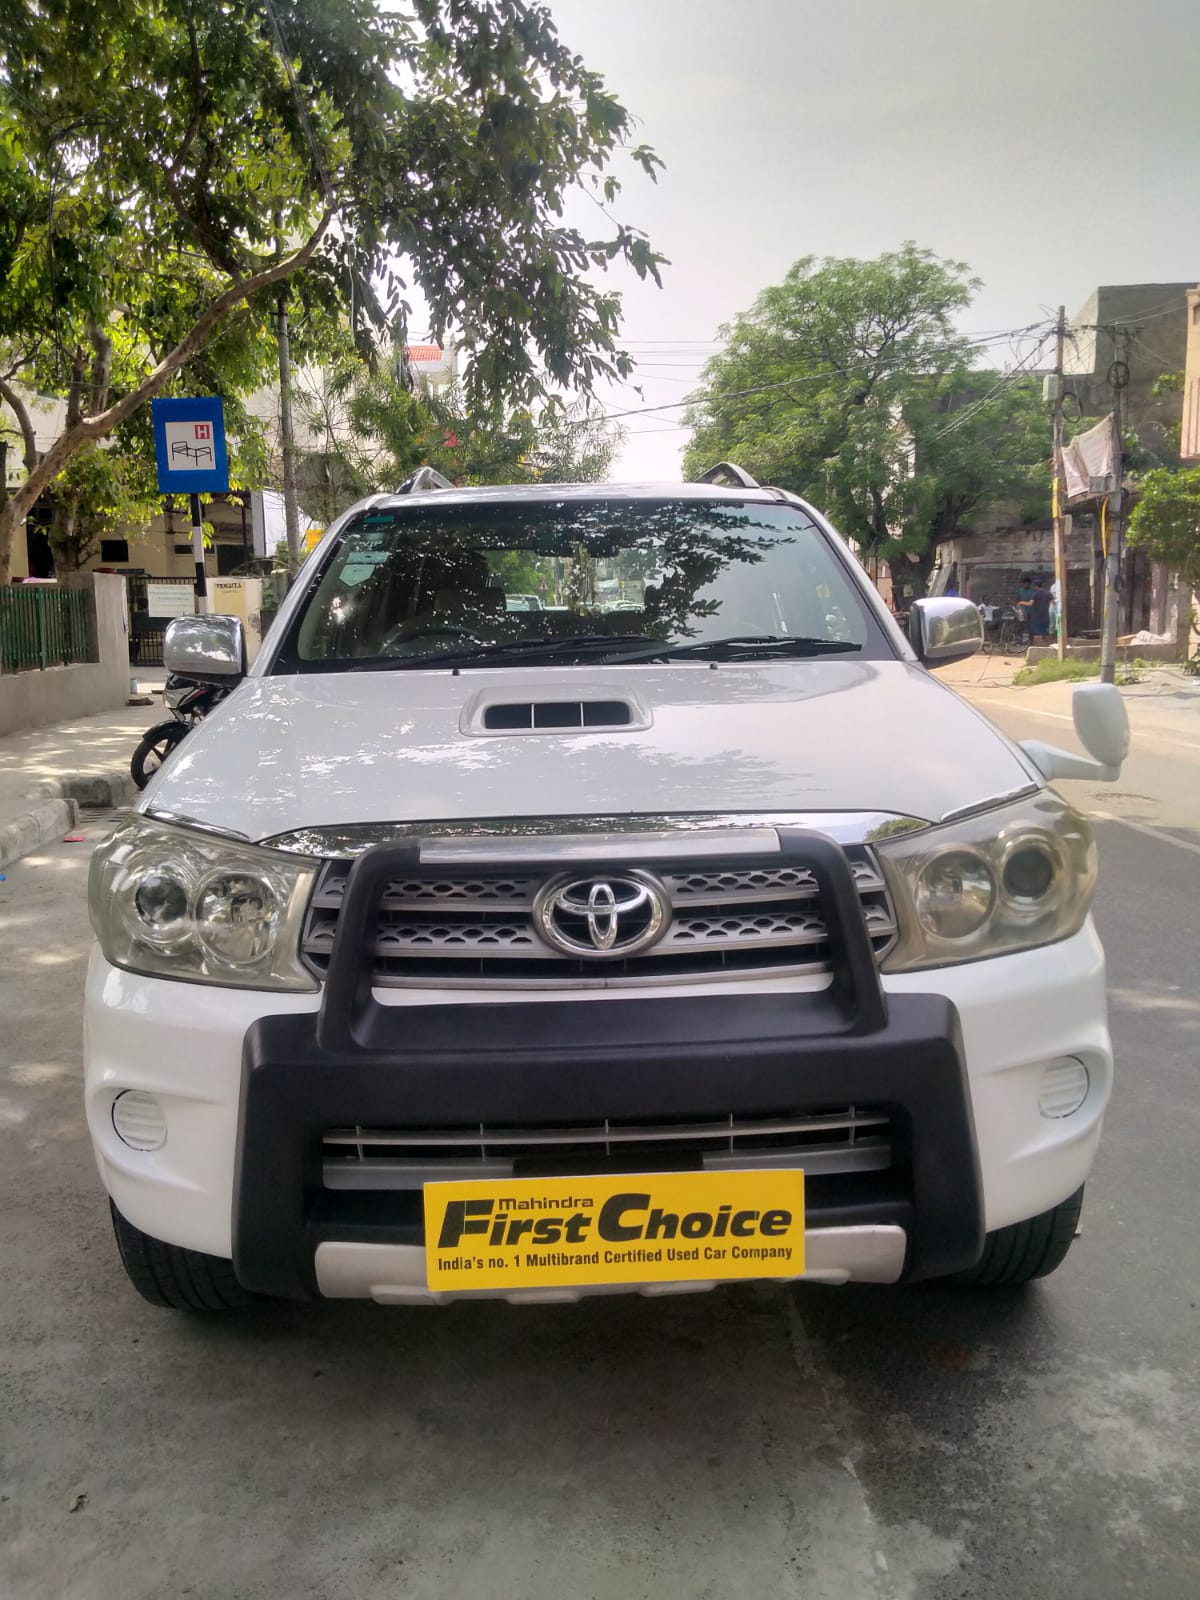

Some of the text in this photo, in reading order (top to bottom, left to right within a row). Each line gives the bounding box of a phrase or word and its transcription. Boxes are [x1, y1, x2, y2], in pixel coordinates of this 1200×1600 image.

[197, 425, 208, 439] H
[498, 1196, 594, 1211] Mahindra
[437, 1193, 793, 1248] First Choice
[438, 1245, 793, 1271] India's no. 1 Multibrand Certified Used Car Company
